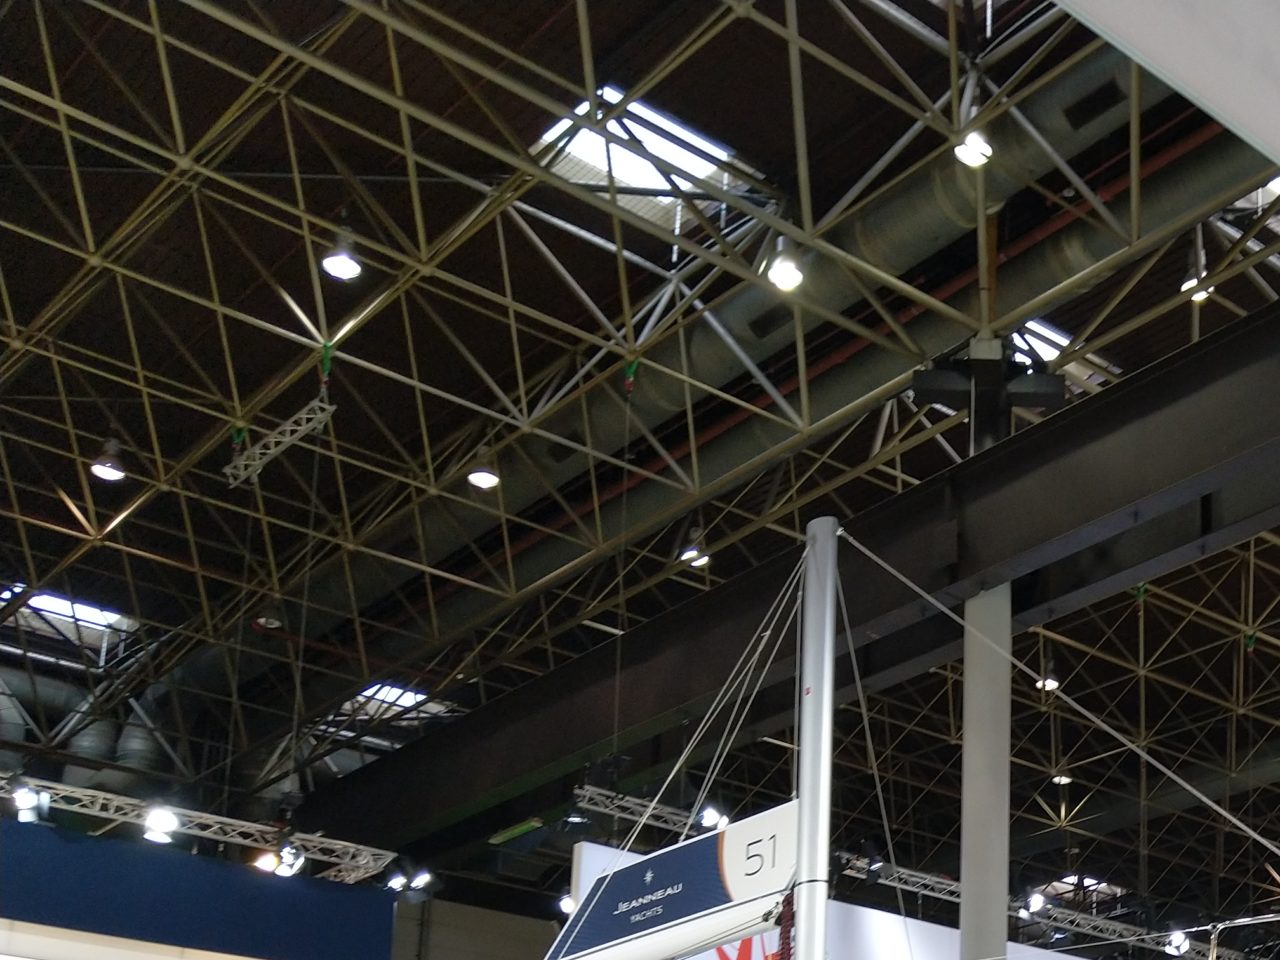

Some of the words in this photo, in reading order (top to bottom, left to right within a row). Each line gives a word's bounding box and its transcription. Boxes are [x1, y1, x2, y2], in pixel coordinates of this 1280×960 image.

[743, 833, 777, 877] 51
[613, 882, 683, 915] JEANNEAU
[629, 905, 664, 923] YACHTS
